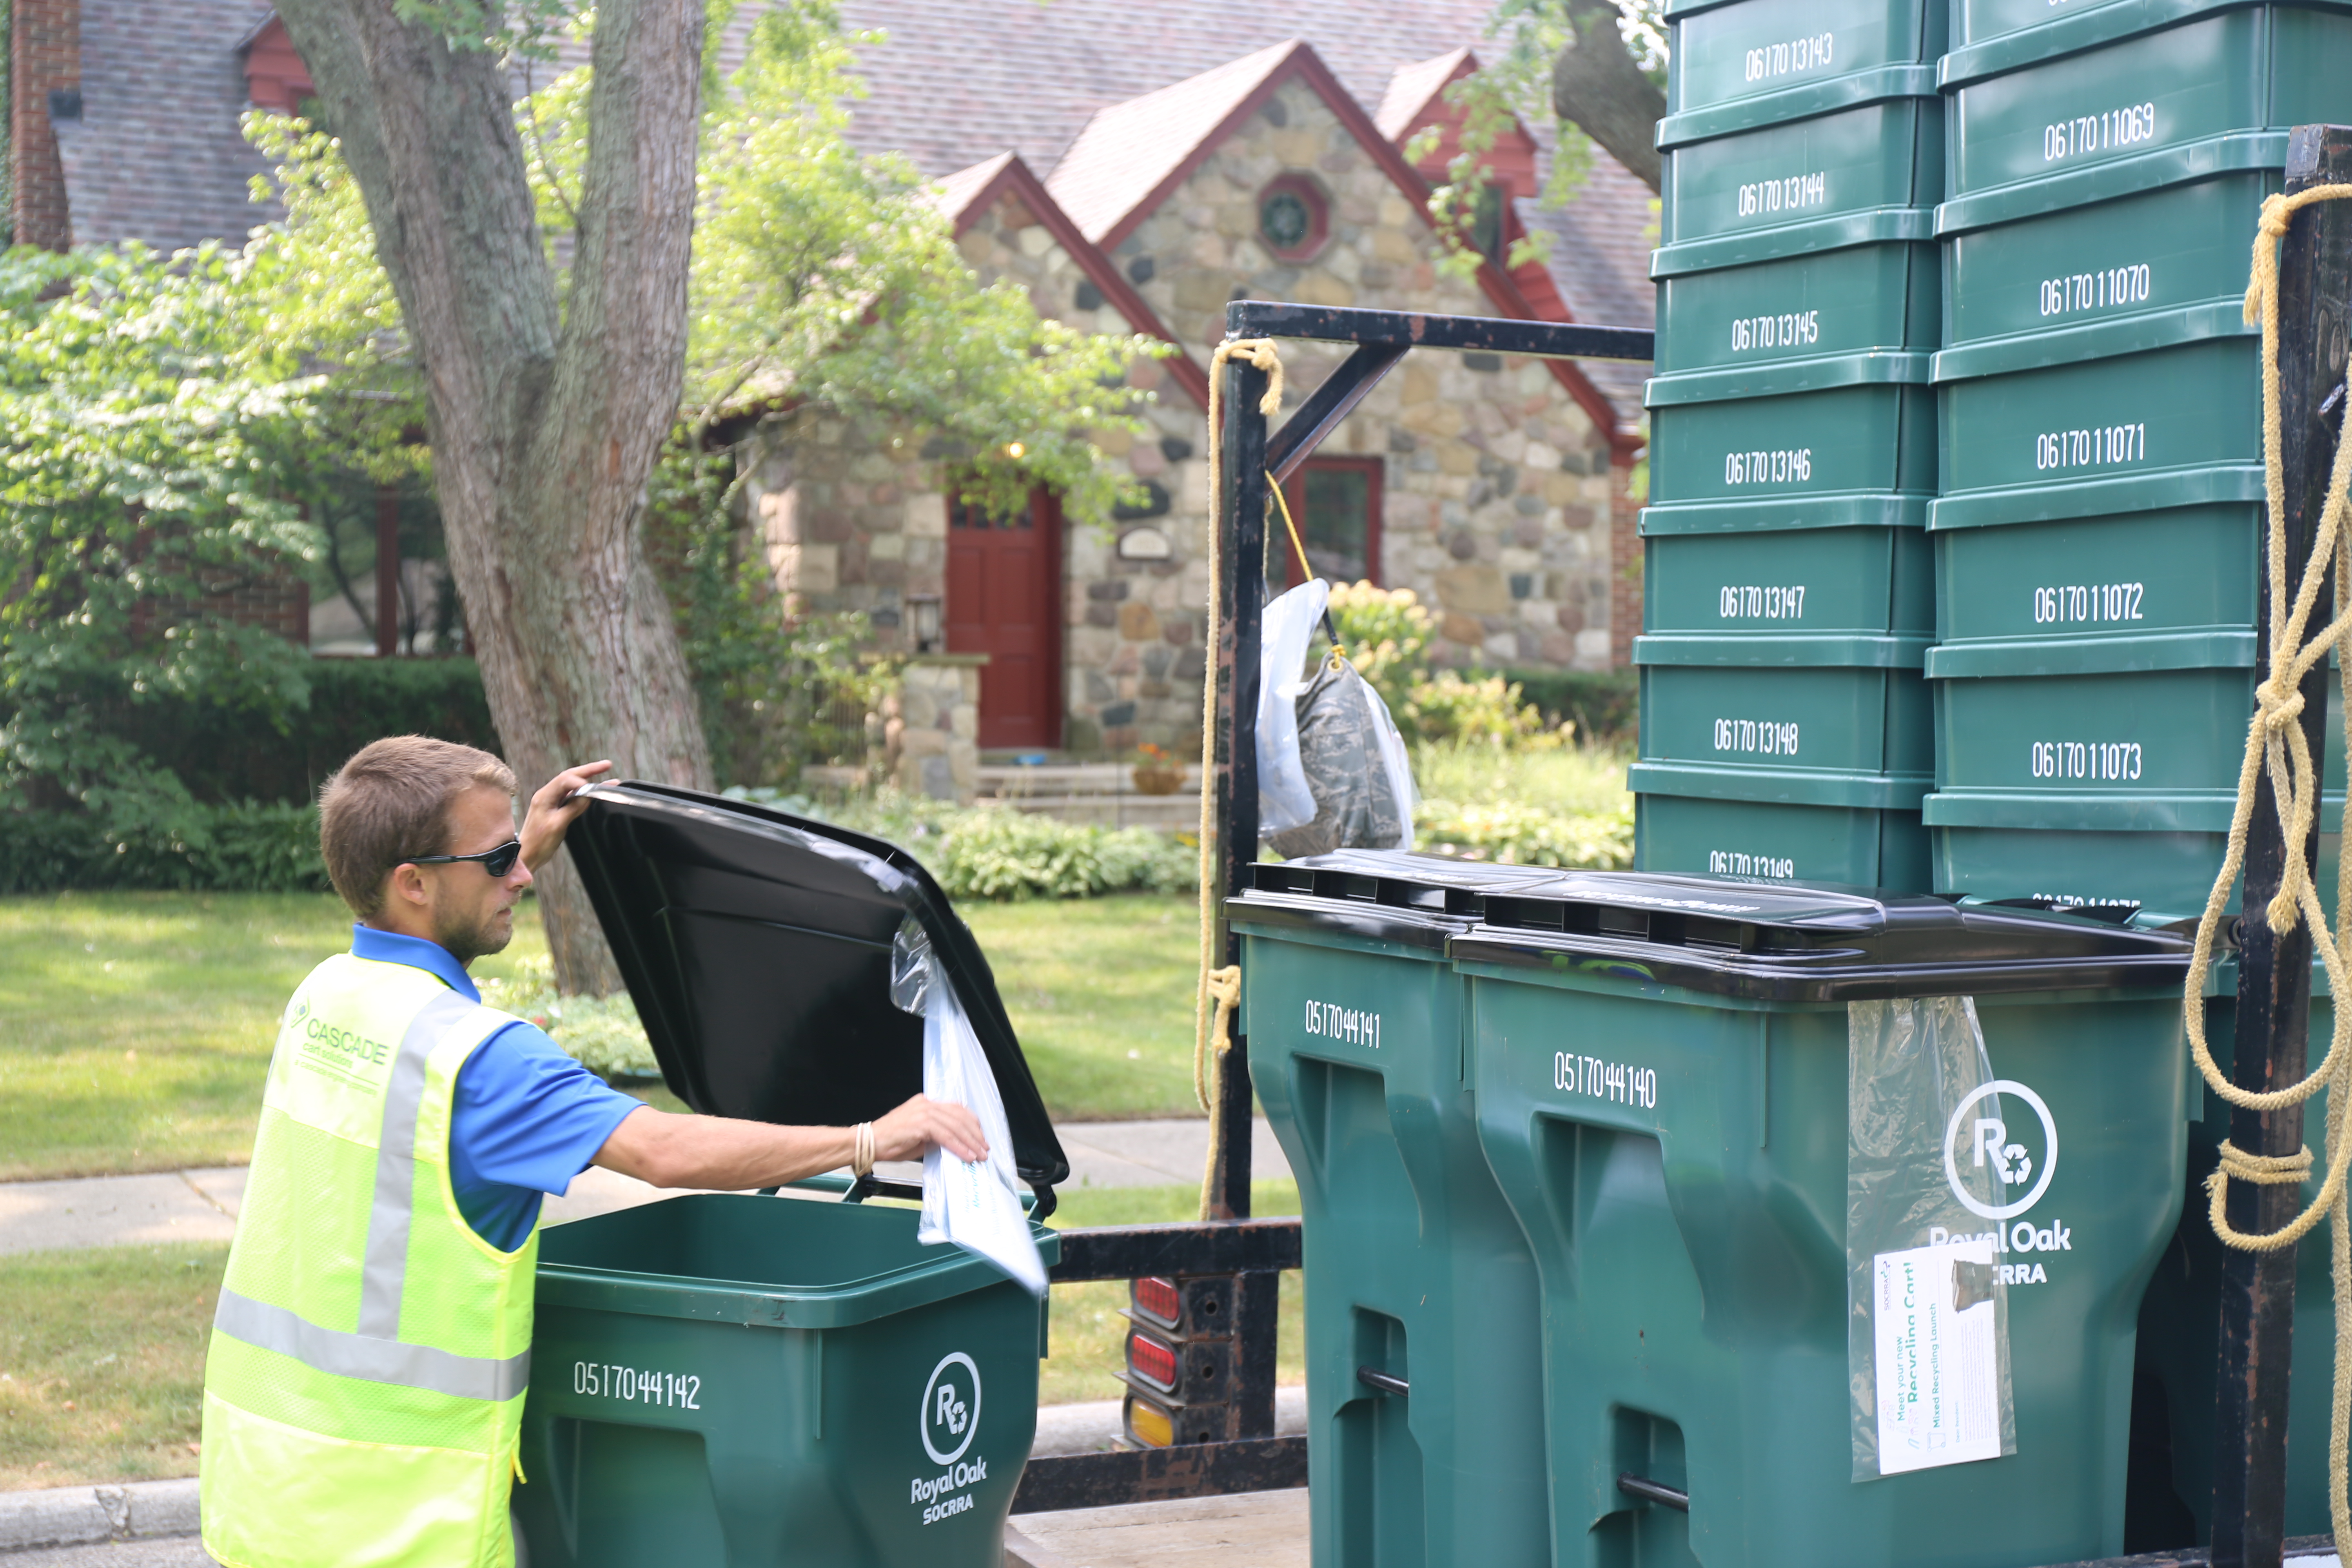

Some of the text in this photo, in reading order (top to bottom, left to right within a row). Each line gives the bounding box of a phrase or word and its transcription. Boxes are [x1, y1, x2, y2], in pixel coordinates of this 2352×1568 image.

[1745, 32, 1833, 82] 0617013143
[2044, 102, 2155, 162] 0617011069
[1738, 171, 1825, 217] 0617013144
[2040, 263, 2150, 317] 0617011070
[1731, 310, 1818, 352] 0617013145
[1725, 448, 1811, 485] 0617013146
[2037, 422, 2145, 470] 0617011071
[1720, 586, 1805, 619] 0617013147
[2035, 582, 2144, 624] 0617011072
[1714, 718, 1799, 755] 0617013148
[2032, 741, 2142, 780] 0617011073
[307, 1018, 390, 1066] CASCADE
[1305, 999, 1380, 1049] 0517044141
[1555, 1051, 1656, 1109] 0517044140
[2011, 1219, 2072, 1253] Oak
[575, 1361, 701, 1410] 0517044142
[1898, 1363, 1906, 1389] your
[1929, 1303, 1940, 1428] Mixed Recycling Launch
[1897, 1391, 1905, 1421] Meet
[911, 1455, 987, 1505] Royal Oak
[922, 1493, 974, 1526] SOCRRA
